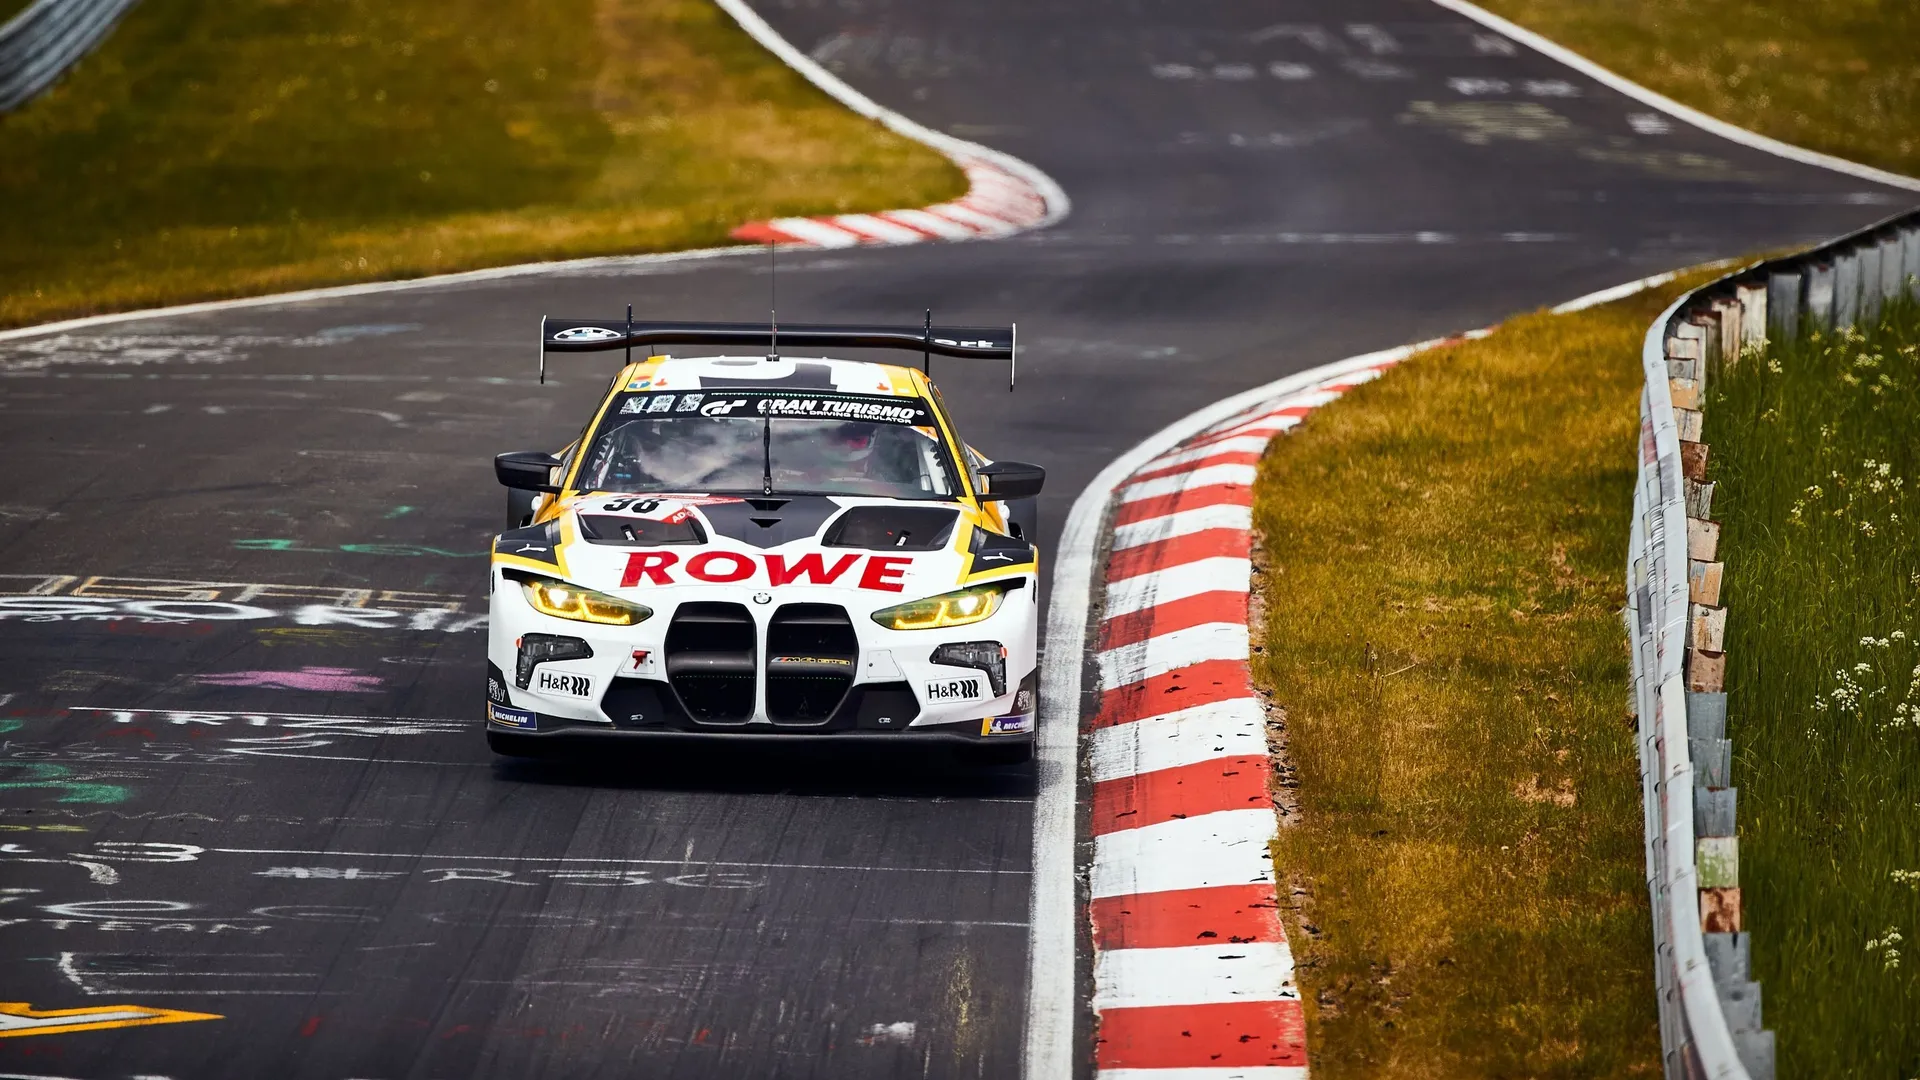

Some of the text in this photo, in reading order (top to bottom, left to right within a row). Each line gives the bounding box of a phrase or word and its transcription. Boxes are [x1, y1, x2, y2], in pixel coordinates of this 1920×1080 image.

[757, 398, 817, 414] GRAN
[809, 410, 851, 418] DRIVING
[853, 413, 912, 424] SIMULATOR
[619, 550, 914, 593] ROWE
[494, 711, 528, 724] MICHELIN
